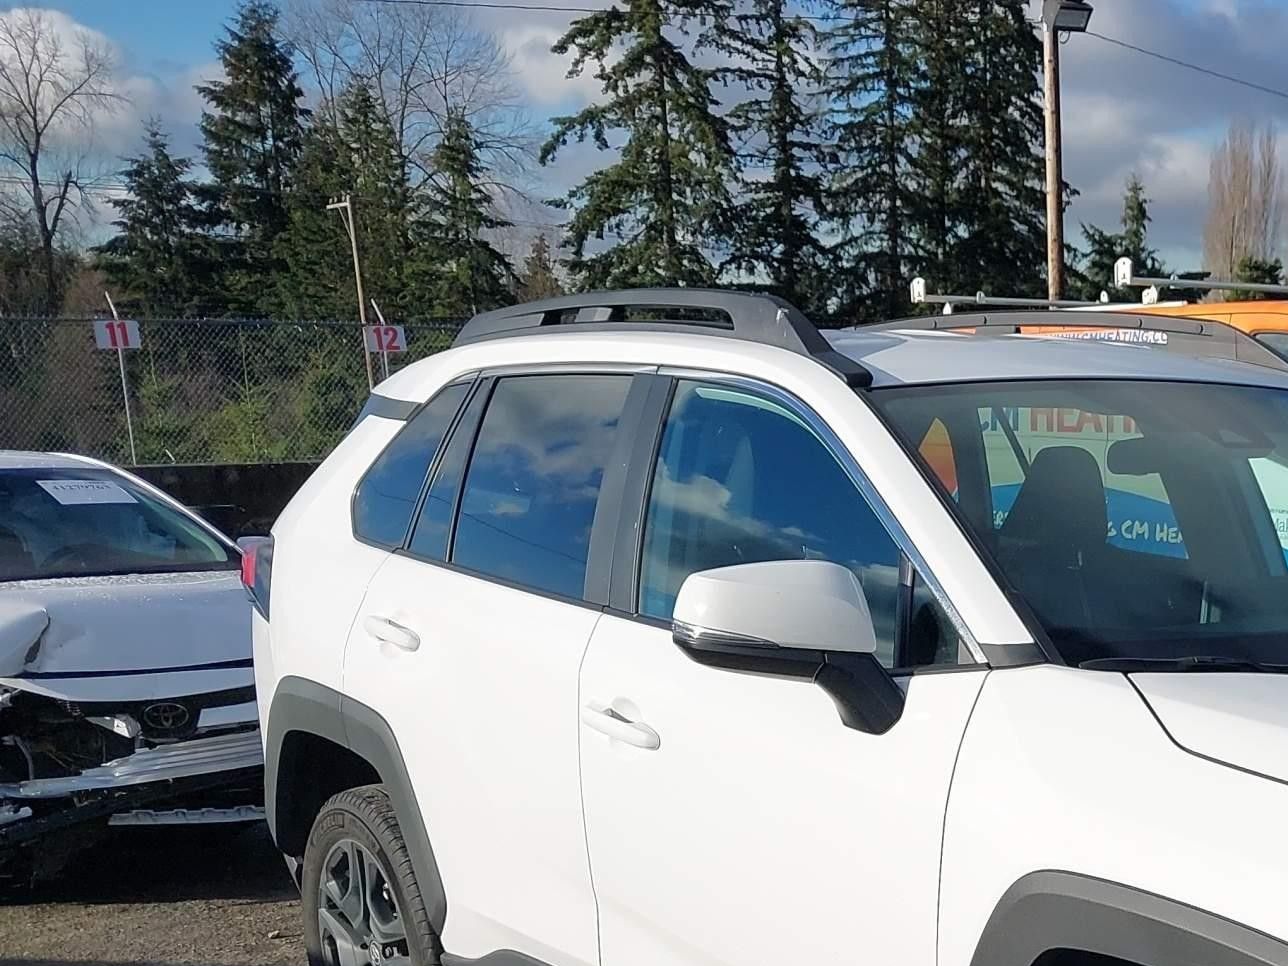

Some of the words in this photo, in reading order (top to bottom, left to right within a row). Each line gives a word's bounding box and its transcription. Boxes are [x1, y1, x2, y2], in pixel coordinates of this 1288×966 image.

[105, 321, 129, 347] 11
[373, 326, 400, 350] 12
[1121, 520, 1149, 540] CM
